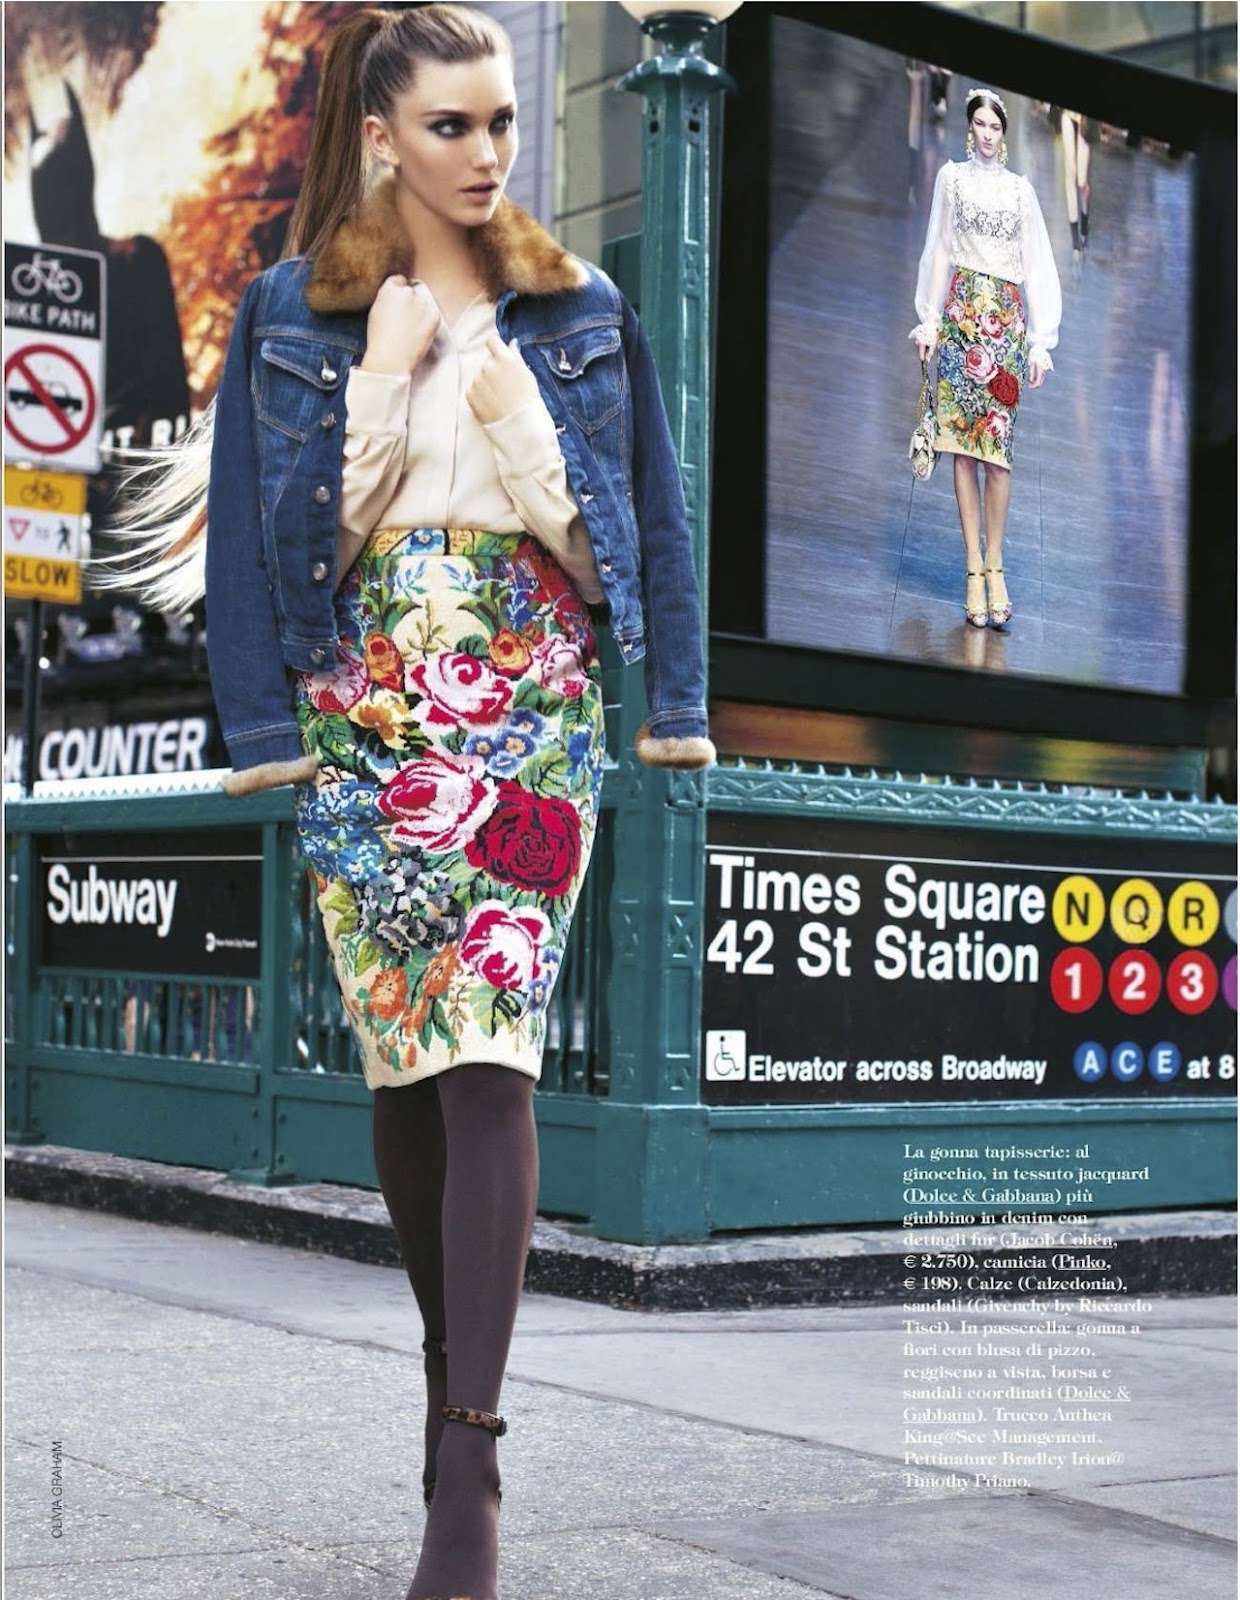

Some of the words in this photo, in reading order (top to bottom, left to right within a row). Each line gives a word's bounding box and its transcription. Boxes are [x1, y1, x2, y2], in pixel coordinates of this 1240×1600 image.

[47, 305, 95, 331] PATH
[6, 558, 70, 587] SLOW
[39, 717, 206, 781] COUNTER
[47, 864, 177, 938] Subway
[709, 854, 861, 915] Times
[883, 864, 1046, 930] Square
[1066, 893, 1090, 926] N
[1124, 896, 1149, 928] Q
[1182, 897, 1205, 930] R
[706, 920, 775, 975] 42
[797, 922, 851, 977] St
[874, 926, 1039, 982] Station
[1064, 965, 1081, 999] 1
[1122, 963, 1146, 999] 2
[1179, 965, 1204, 1000] 3
[748, 1054, 846, 1081] Elevator
[856, 1059, 933, 1080] across
[942, 1055, 1048, 1084] Broadway
[1082, 1050, 1099, 1073] A
[1119, 1050, 1137, 1072] C
[1157, 1050, 1172, 1072] E
[1187, 1057, 1210, 1079] at
